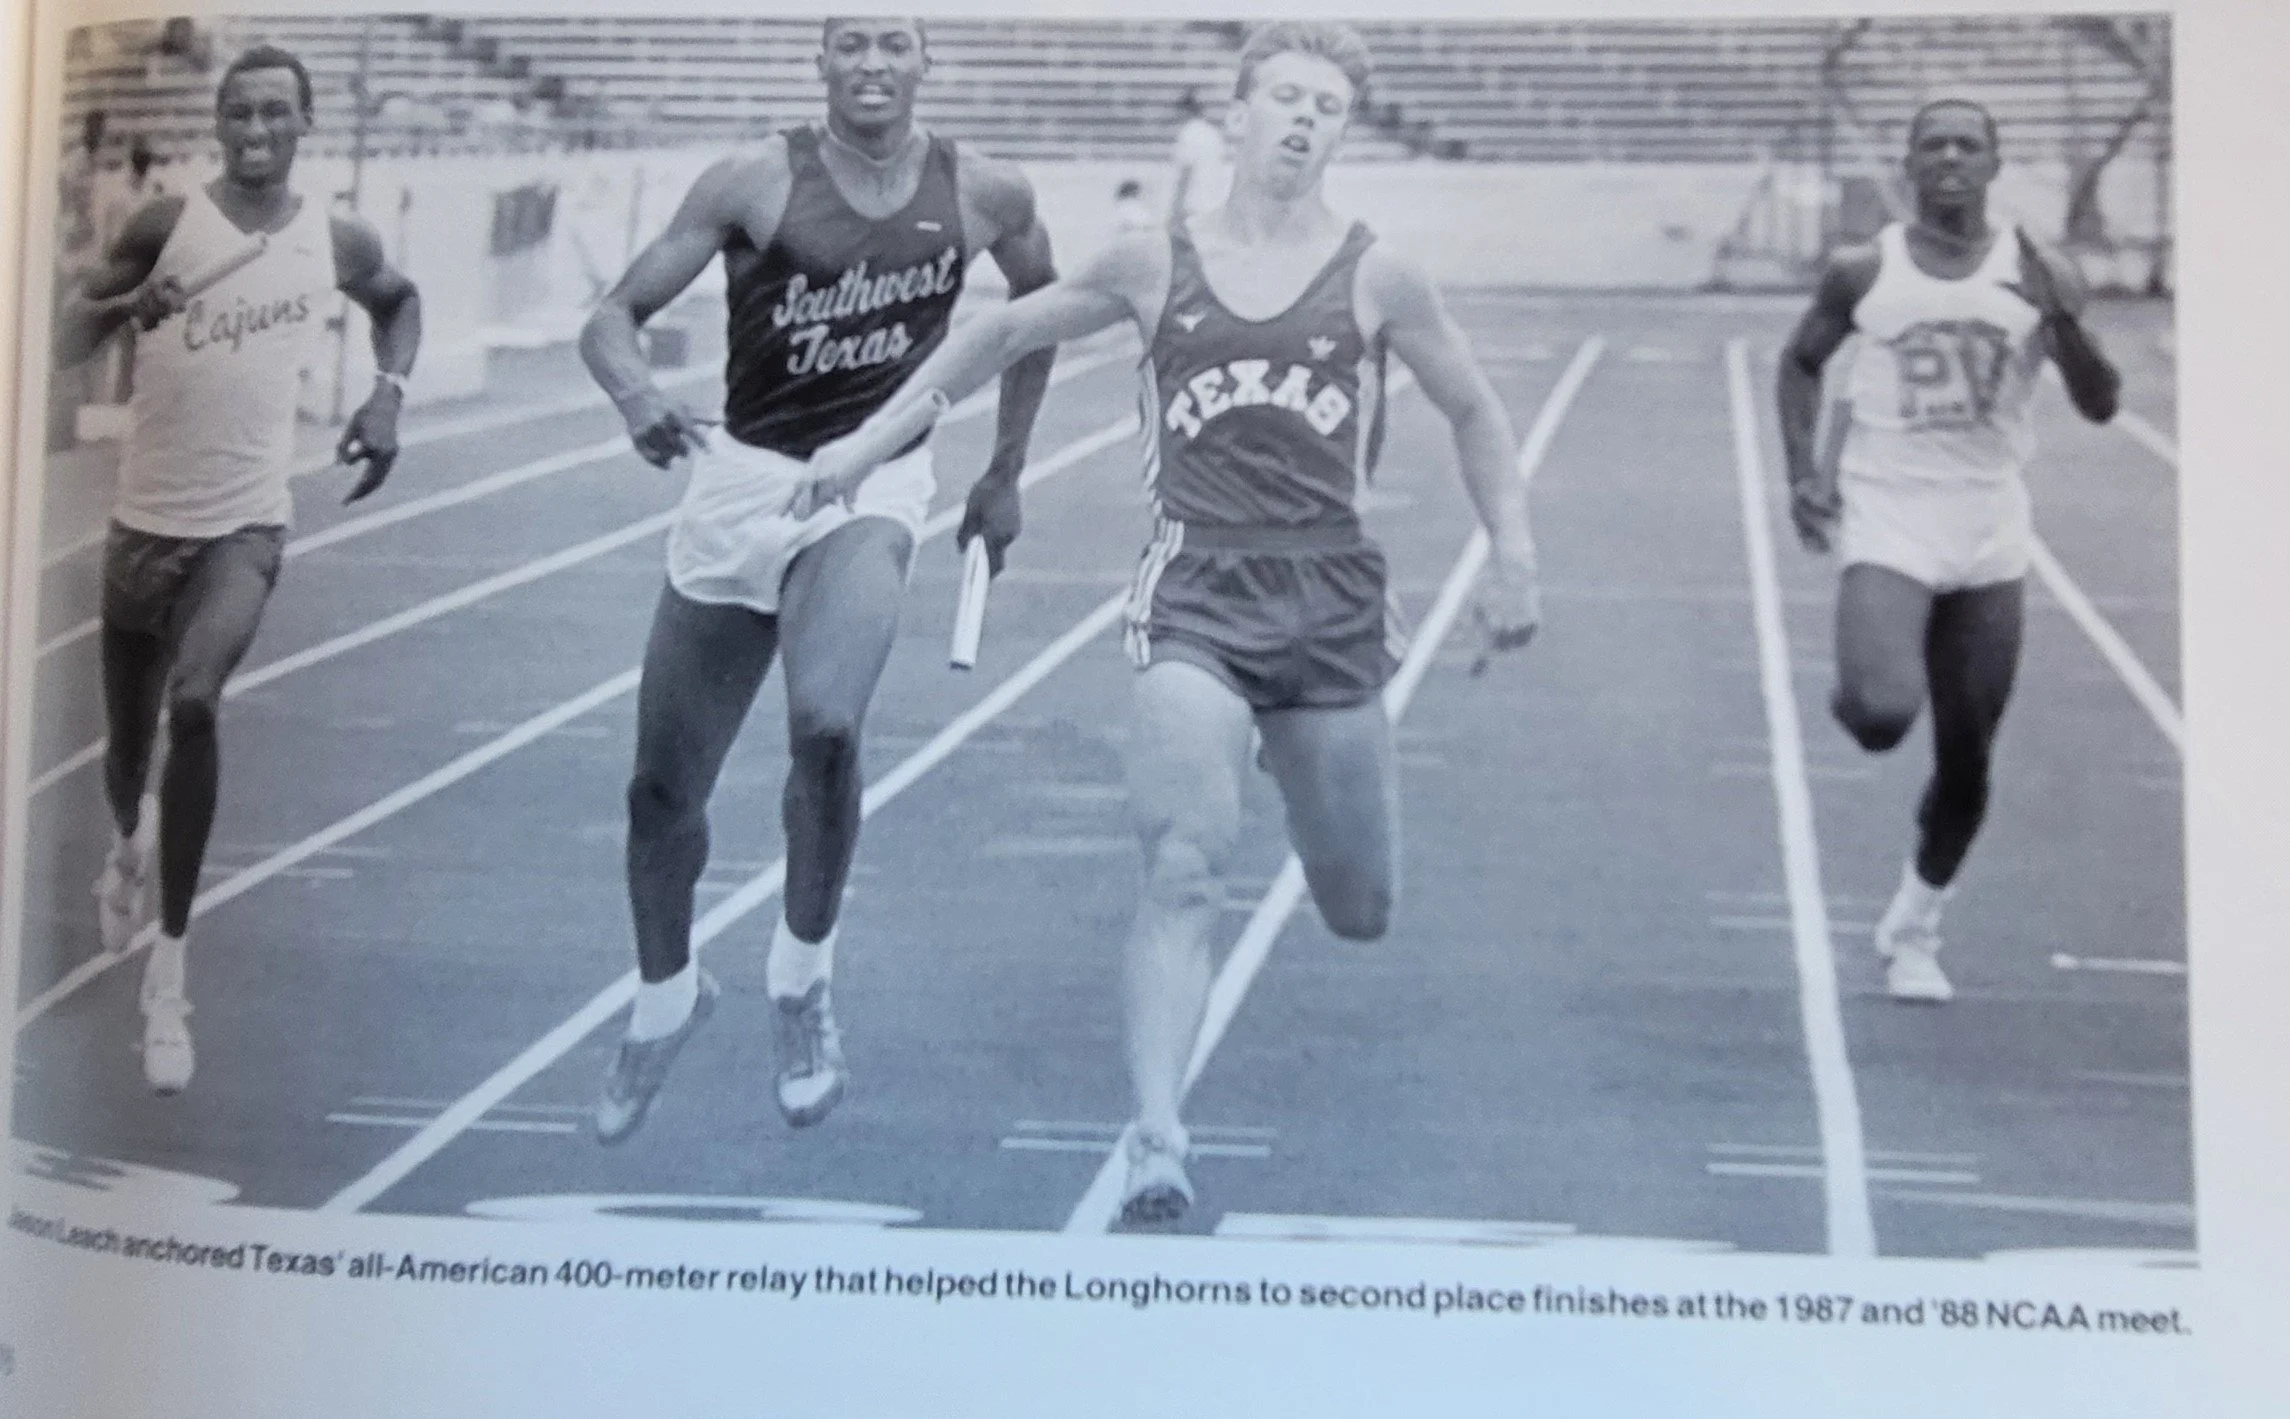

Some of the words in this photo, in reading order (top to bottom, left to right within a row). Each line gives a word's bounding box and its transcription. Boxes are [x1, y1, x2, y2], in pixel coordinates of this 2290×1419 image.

[183, 293, 310, 353] Cajuns
[772, 246, 958, 328] Southwest
[786, 322, 914, 375] Texas
[1165, 359, 1351, 439] TEXAS
[122, 1231, 246, 1272] anchored
[250, 1243, 346, 1277] Texas'
[347, 1251, 548, 1285] all-American
[555, 1259, 718, 1290] 400-meter
[726, 1264, 806, 1301] relay
[814, 1266, 876, 1293] that
[885, 1267, 998, 1304] helped
[1005, 1270, 1056, 1298] the
[1064, 1270, 1251, 1309] Longhorns
[1259, 1278, 1292, 1306] to
[1300, 1281, 1426, 1309] second
[1433, 1281, 1526, 1318] place
[1533, 1284, 1669, 1318] finishes
[1676, 1292, 1707, 1319] at
[1713, 1289, 1768, 1321] the
[1775, 1293, 1854, 1323] 1987
[1860, 1299, 1926, 1327] and
[1931, 1298, 1980, 1328] '88
[1986, 1299, 2090, 1331] NCAA
[2097, 1307, 2193, 1336] meet.
